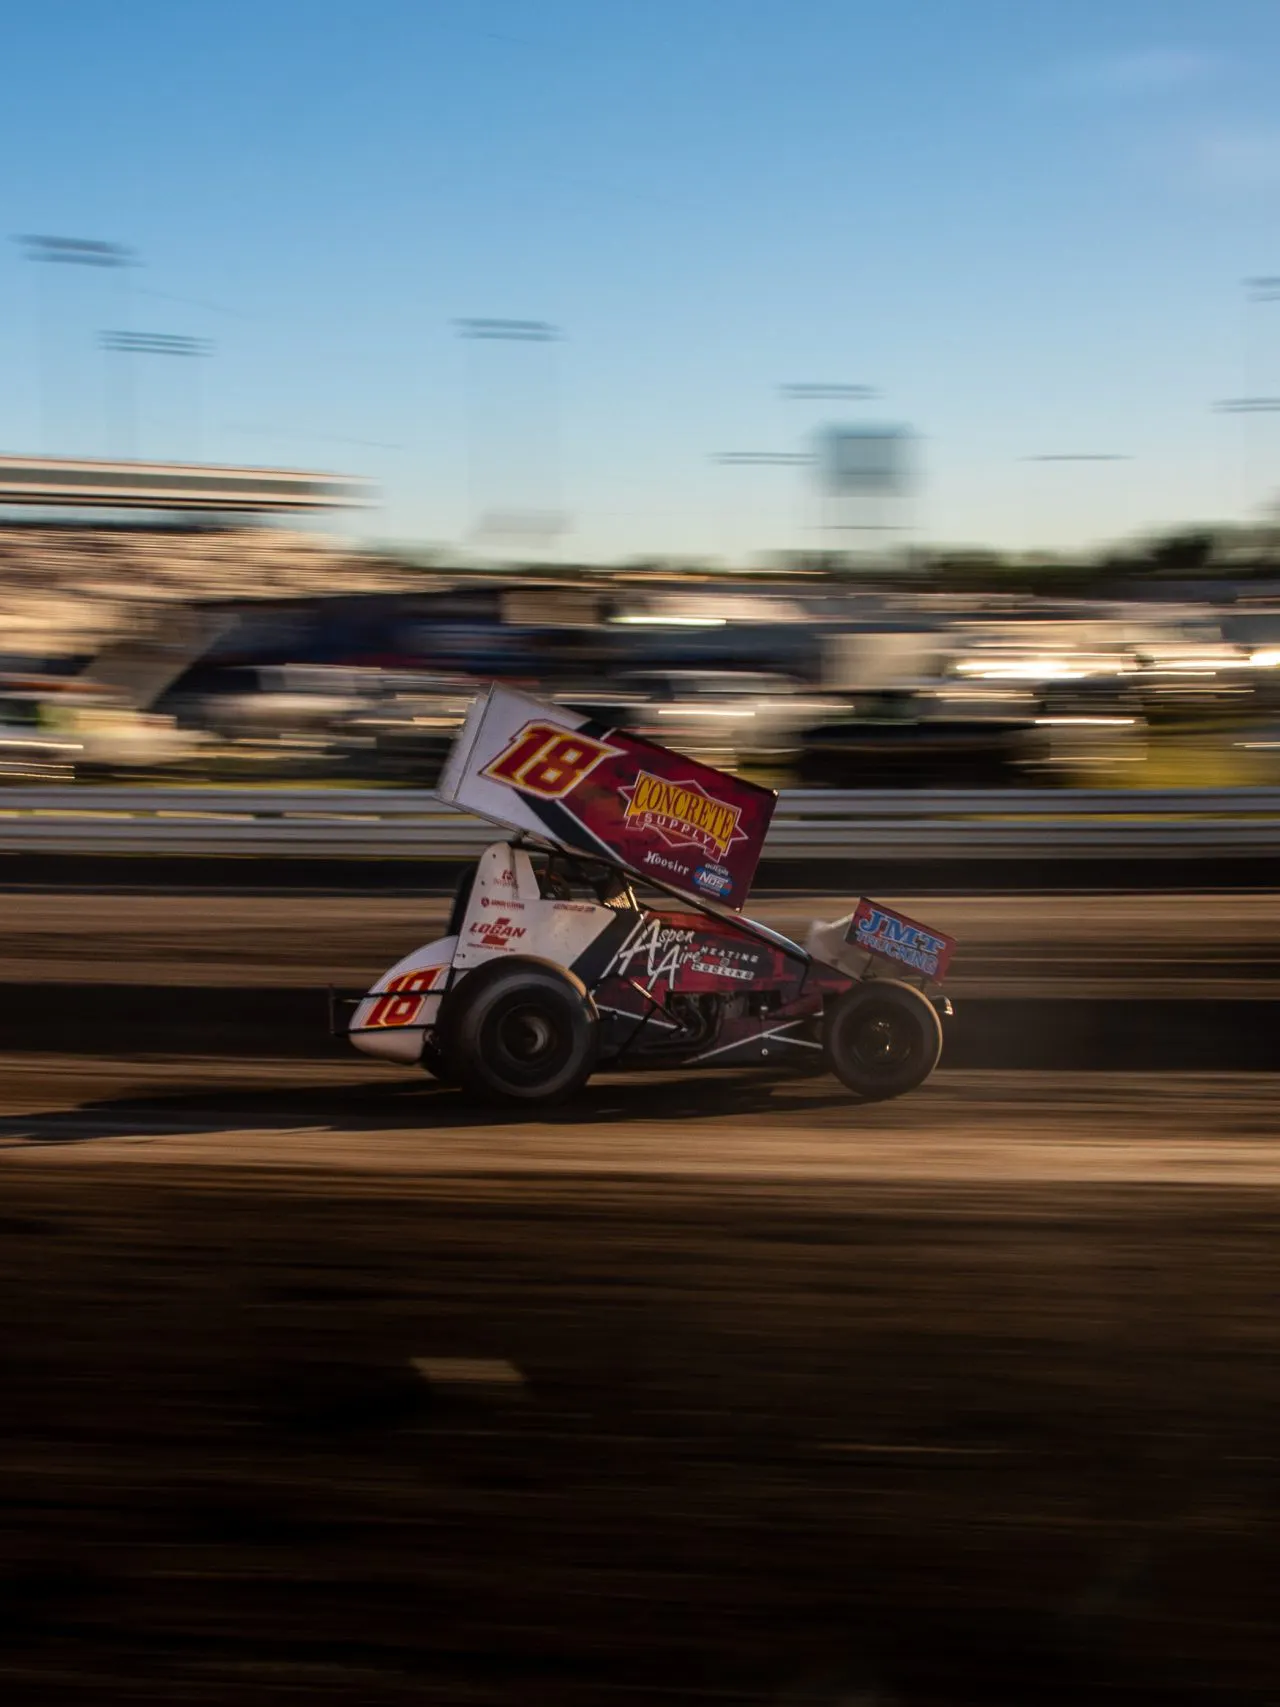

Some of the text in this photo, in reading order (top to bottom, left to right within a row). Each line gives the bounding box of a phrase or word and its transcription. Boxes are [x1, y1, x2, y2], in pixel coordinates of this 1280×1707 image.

[480, 720, 616, 798] 18
[634, 777, 736, 842] CONCRETE
[644, 812, 711, 845] SUPPLY
[644, 850, 690, 875] Hoosier
[469, 922, 527, 938] LOGAN
[856, 929, 938, 975] TRUCKING
[859, 908, 946, 954] JMT
[362, 966, 442, 1027] 18
